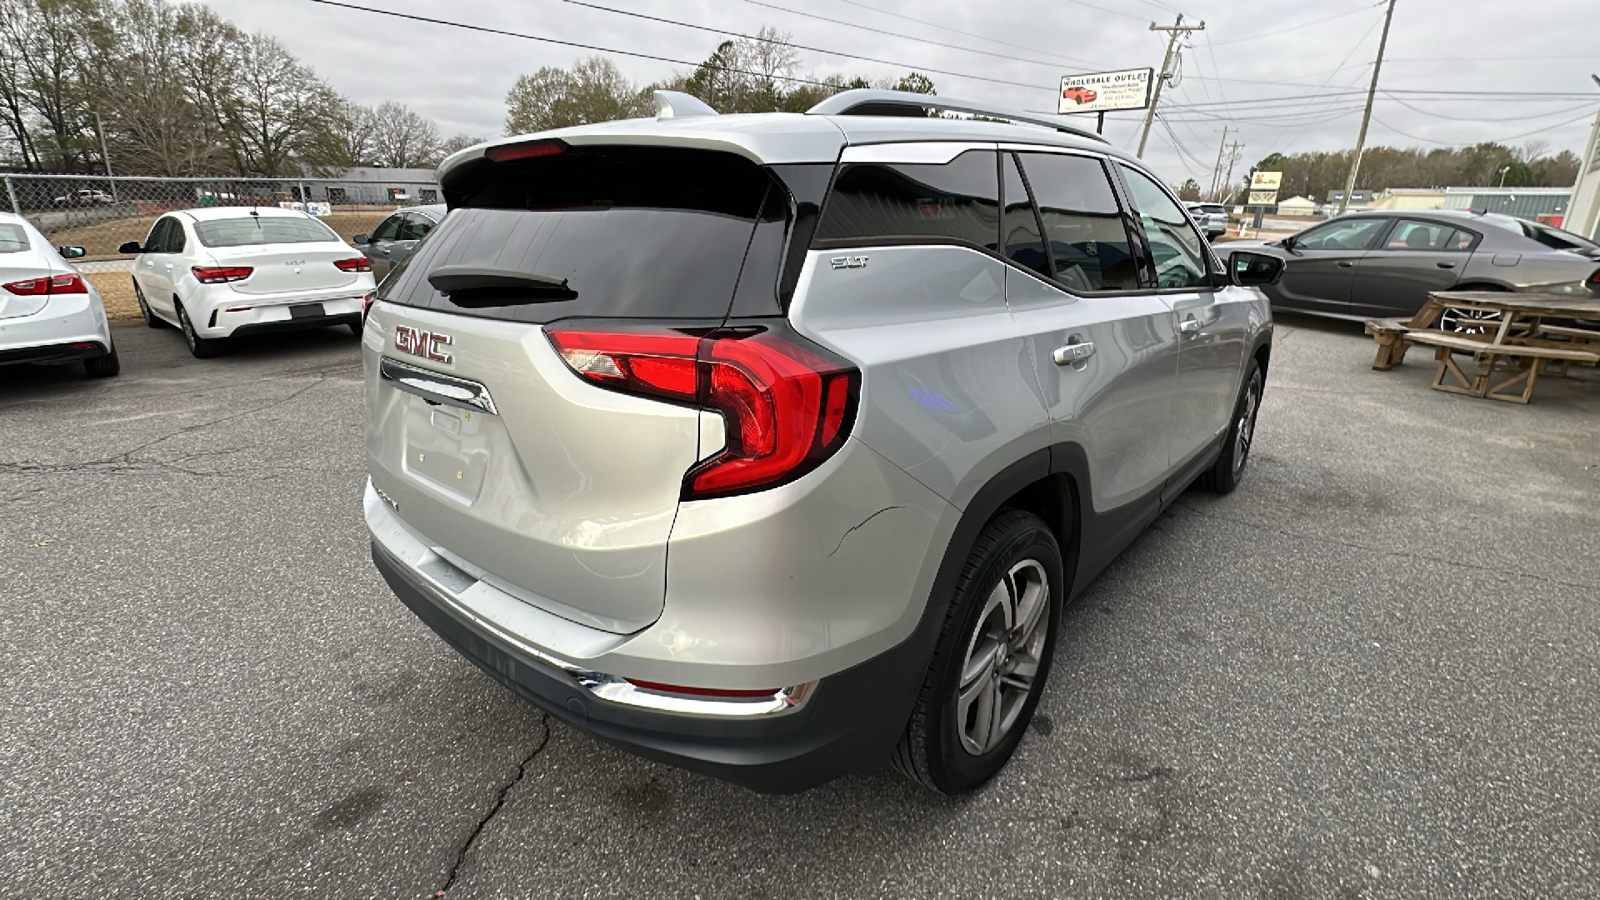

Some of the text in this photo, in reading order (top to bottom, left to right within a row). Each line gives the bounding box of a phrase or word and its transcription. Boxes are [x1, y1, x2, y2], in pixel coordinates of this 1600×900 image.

[1063, 77, 1111, 86] WHOLESALE
[1115, 72, 1147, 82] OUTLET
[831, 256, 869, 270] SLT
[395, 324, 454, 364] GMC
